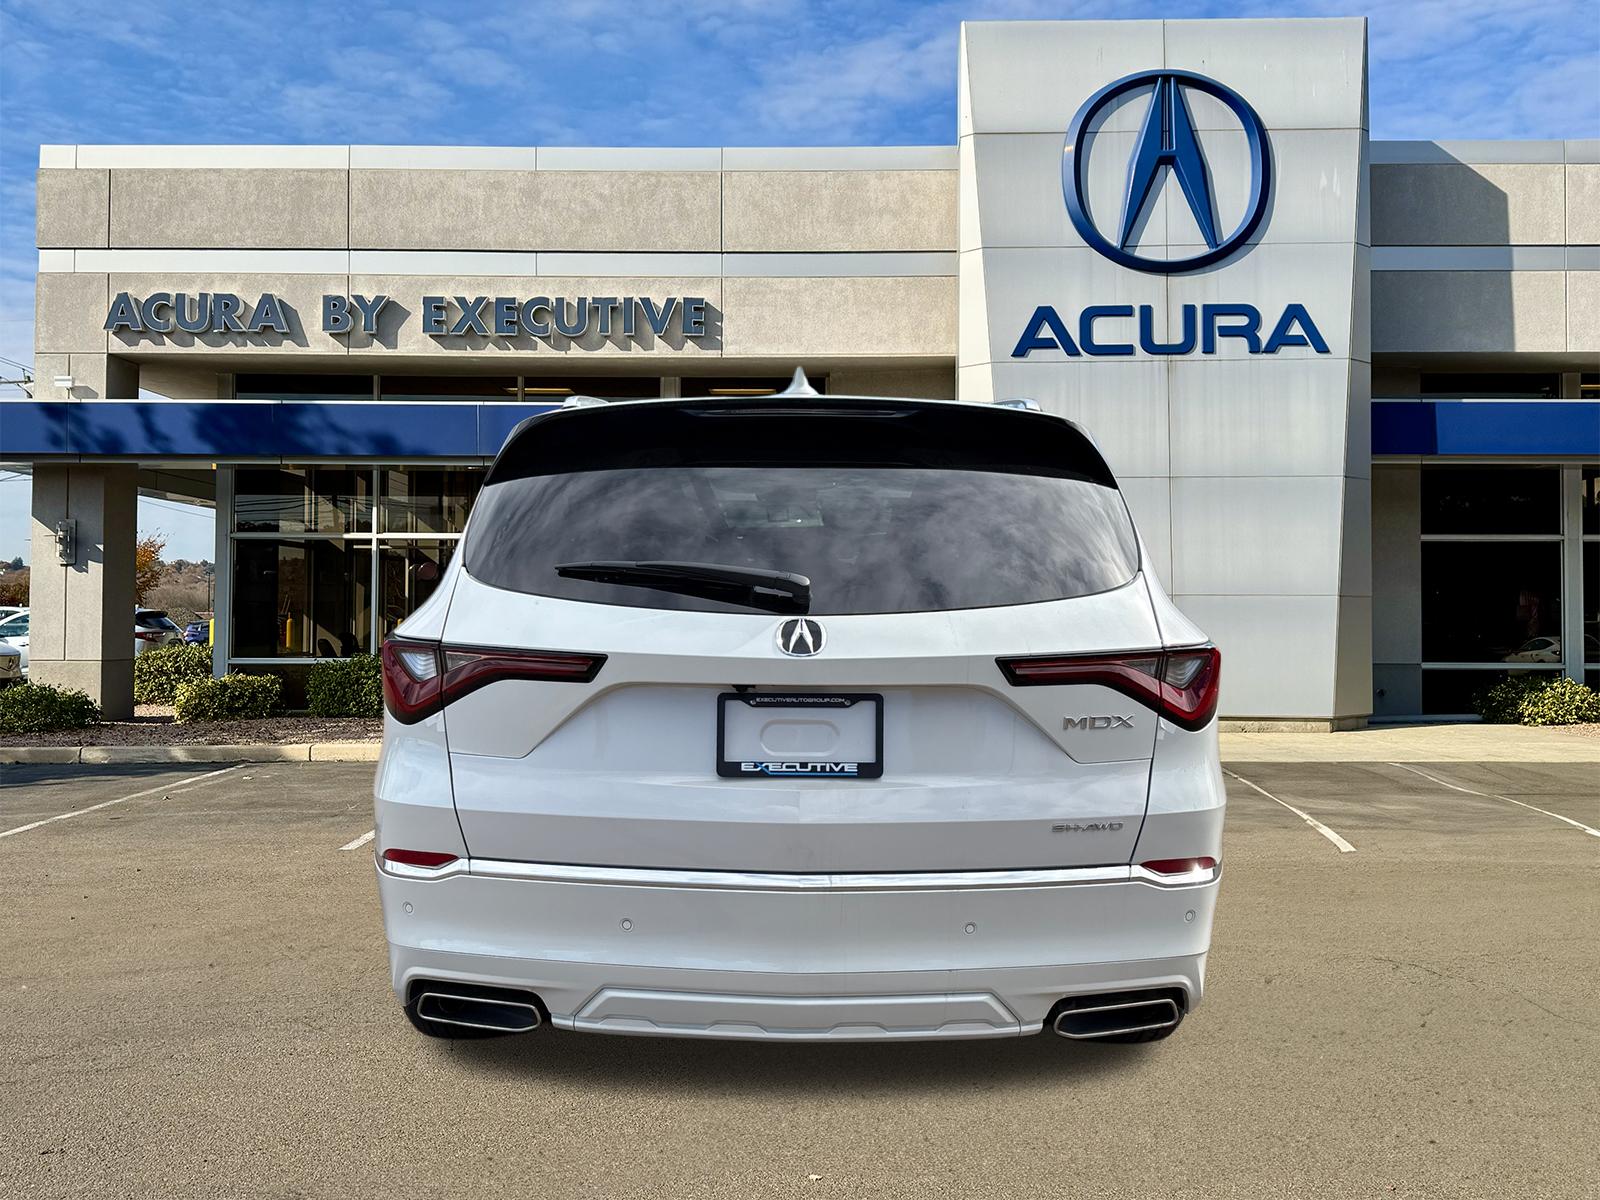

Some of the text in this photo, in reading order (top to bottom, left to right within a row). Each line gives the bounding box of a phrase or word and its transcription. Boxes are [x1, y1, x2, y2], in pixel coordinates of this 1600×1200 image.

[103, 291, 707, 336] ACURA BY EXECUTIVE
[1011, 303, 1331, 357] ACURA
[1063, 715, 1135, 730] MDX
[741, 762, 858, 774] EXECUTIVE
